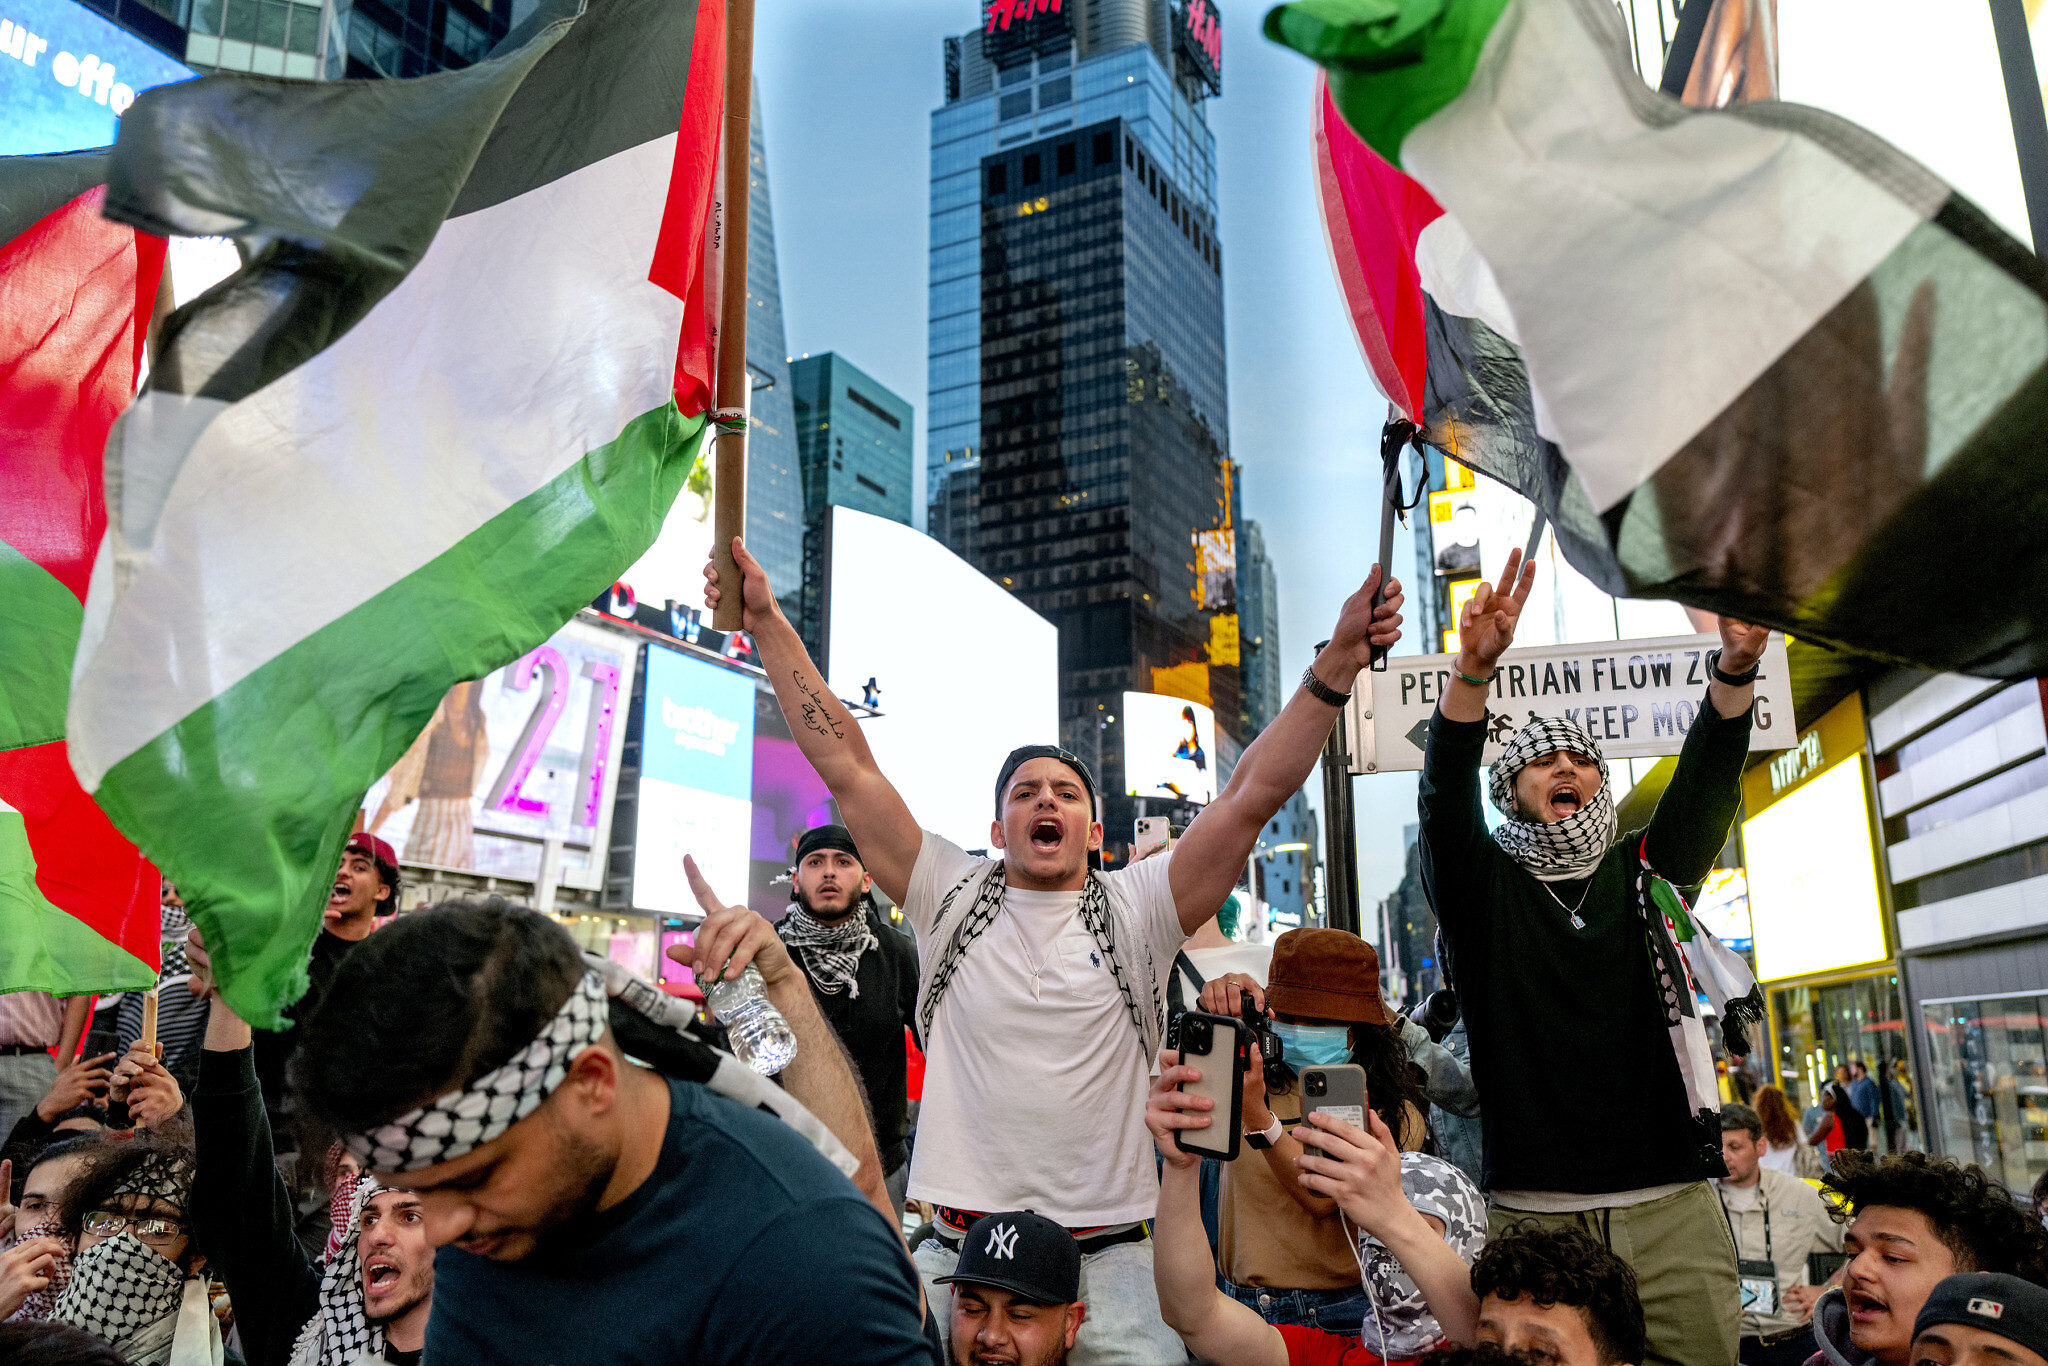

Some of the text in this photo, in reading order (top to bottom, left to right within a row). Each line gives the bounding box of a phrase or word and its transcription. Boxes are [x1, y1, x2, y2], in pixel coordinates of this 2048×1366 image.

[1401, 662, 1580, 705] PEDTRIAN
[1593, 654, 1671, 690] FLOW
[793, 670, 844, 739] فلسطين
[1652, 695, 1772, 737] MOG
[494, 646, 621, 828] 21
[939, 1205, 966, 1227] MA
[985, 1222, 1020, 1260] NY
